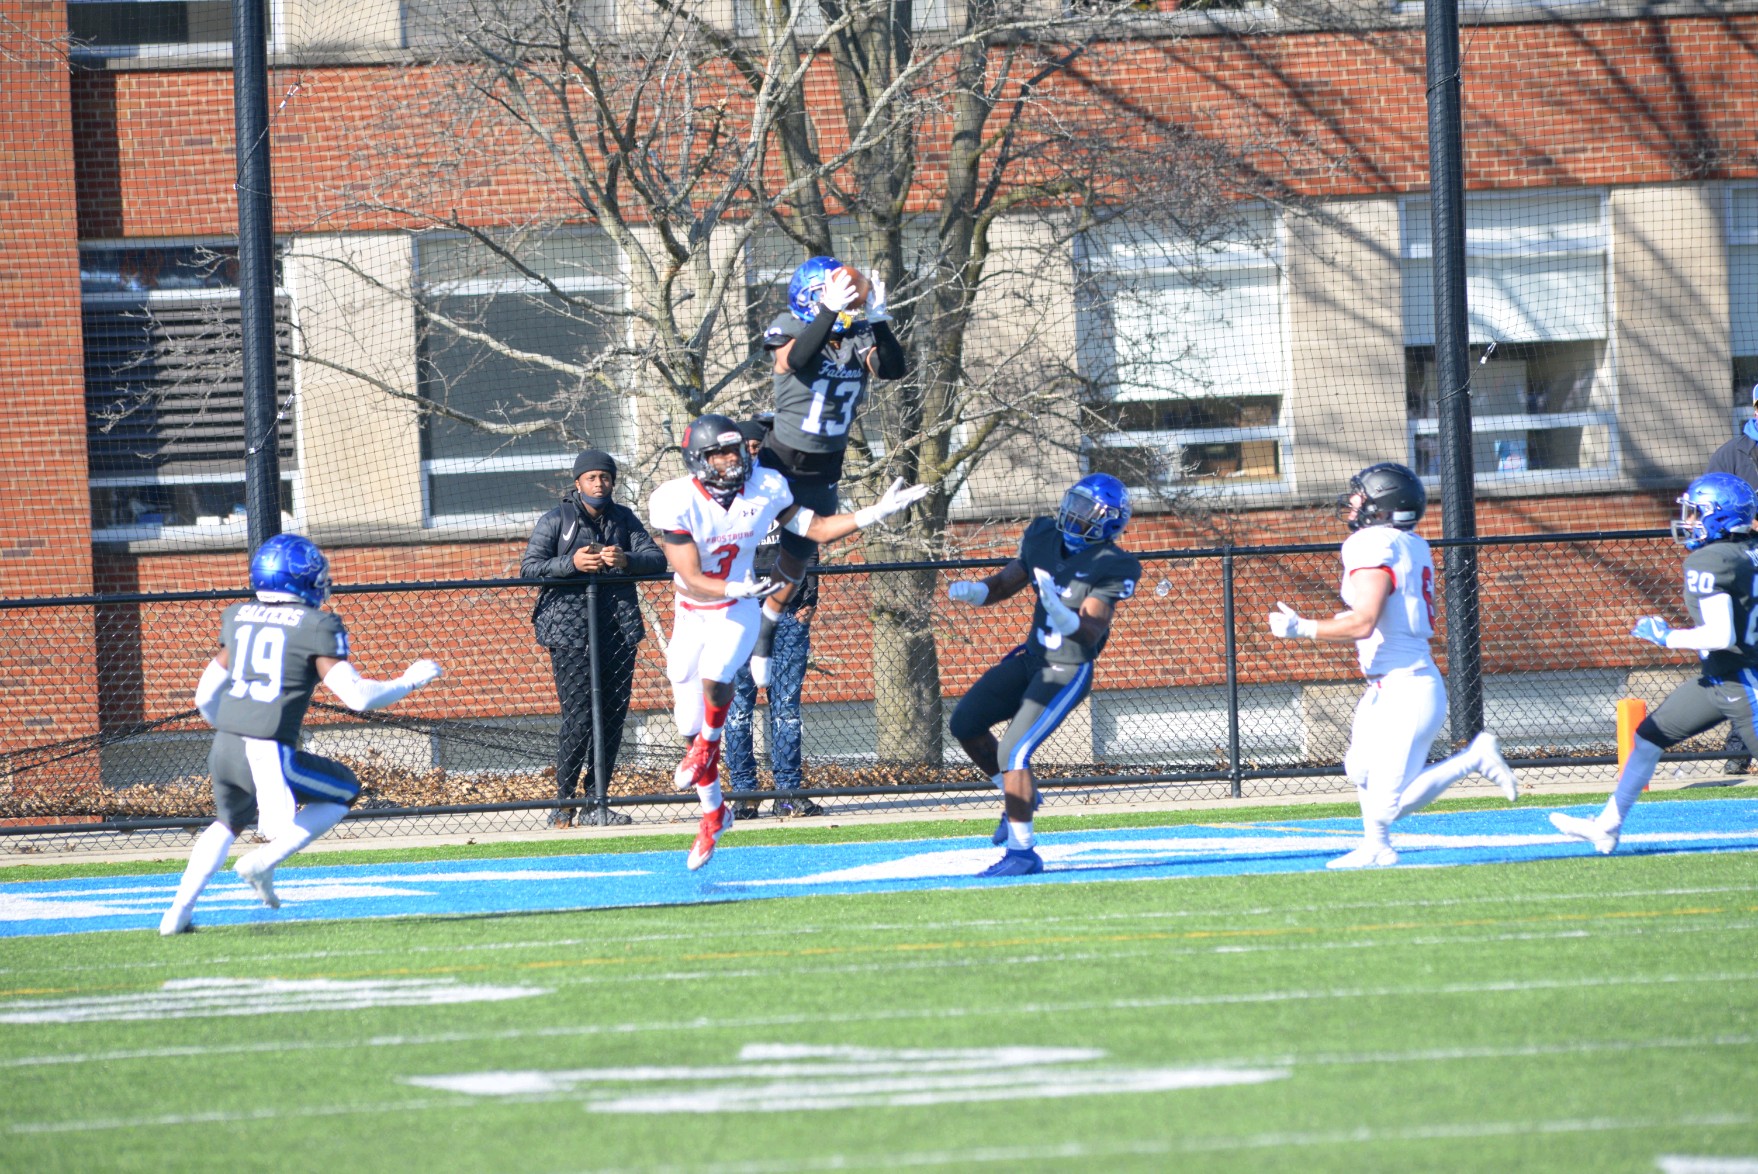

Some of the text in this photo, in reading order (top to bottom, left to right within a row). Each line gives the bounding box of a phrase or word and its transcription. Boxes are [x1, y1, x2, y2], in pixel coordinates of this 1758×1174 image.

[818, 360, 863, 378] Falcons
[801, 378, 861, 436] 13
[702, 543, 740, 580] 3
[1118, 579, 1136, 598] 3
[1686, 569, 1715, 594] 20
[229, 625, 286, 702] 19
